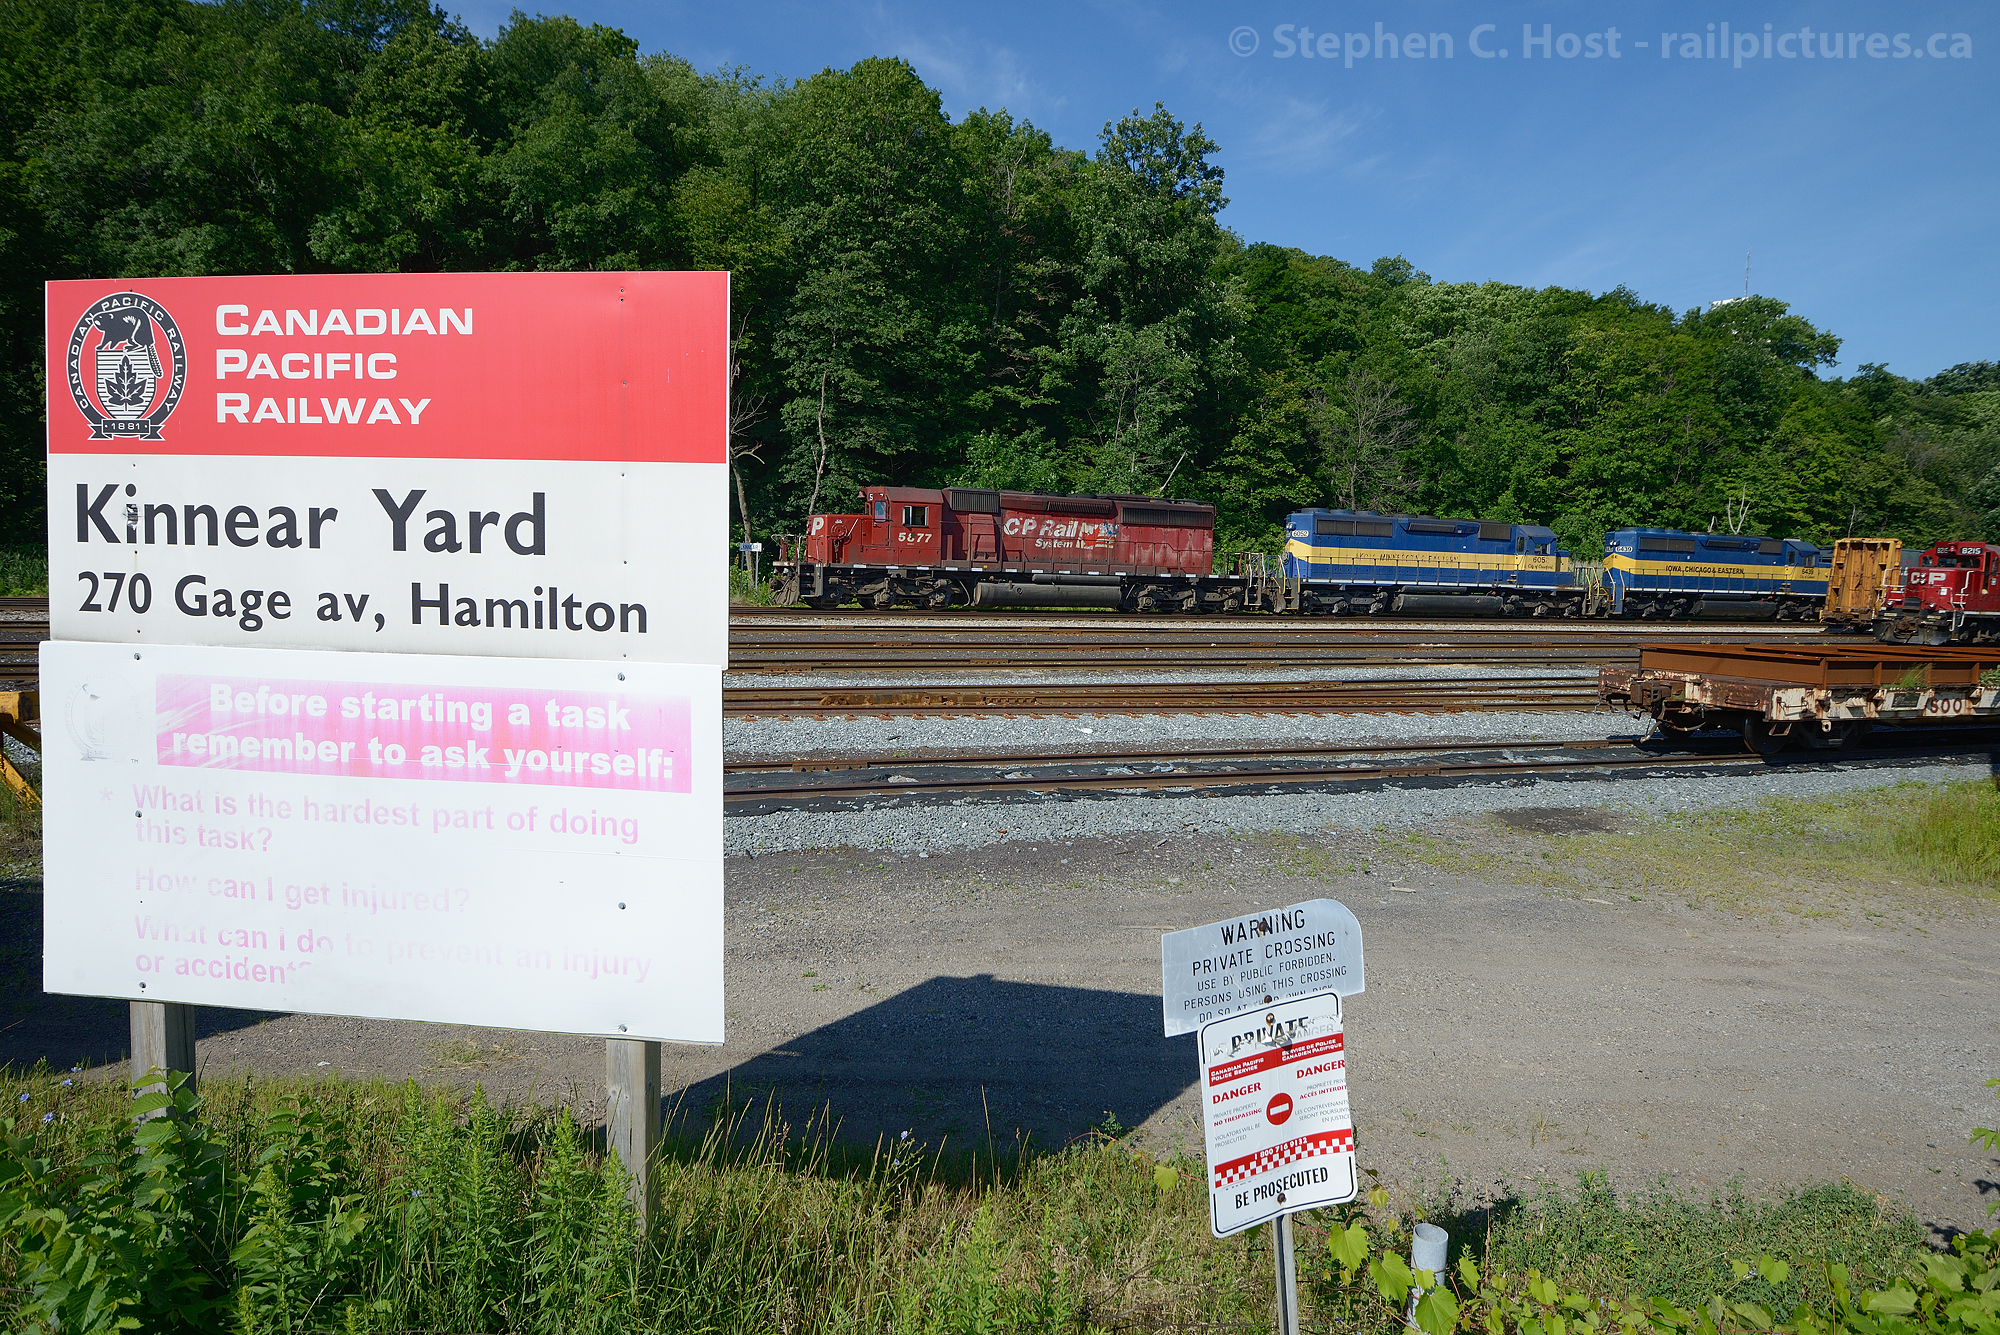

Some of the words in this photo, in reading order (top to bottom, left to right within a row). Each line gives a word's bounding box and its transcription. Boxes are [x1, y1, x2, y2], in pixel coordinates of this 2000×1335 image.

[216, 304, 473, 336] CANADIAN
[70, 312, 94, 409] CANADIAN
[101, 297, 164, 320] PACIFIC
[165, 328, 183, 412] RAILWAY
[216, 348, 398, 380] PACIFIC
[216, 393, 432, 425] RAILWAY
[76, 483, 338, 549] Kinnear
[372, 489, 546, 556] Yard
[1004, 516, 1037, 535] CP
[1039, 520, 1078, 537] Rail
[898, 532, 932, 543] 5877
[1035, 538, 1073, 549] System
[1911, 572, 1946, 584] CP
[78, 572, 152, 615] 270
[175, 575, 292, 634] Gage
[317, 592, 385, 633] av,
[412, 582, 648, 634] Hamilton
[209, 683, 327, 718] Before
[340, 691, 493, 731] starting
[508, 701, 531, 727] a
[545, 697, 631, 732] task
[173, 728, 355, 765] remember
[368, 735, 406, 766] to
[421, 741, 490, 770] ask
[505, 745, 673, 779] yourself:
[133, 783, 203, 814] What
[215, 790, 237, 816] is
[248, 792, 292, 820] the
[304, 795, 420, 827] hardest
[433, 804, 495, 833] part
[507, 806, 538, 832] of
[549, 809, 639, 844] doing
[135, 817, 187, 846] this
[198, 823, 273, 853] task?
[135, 867, 197, 893] How
[208, 873, 256, 901] can
[266, 877, 273, 901] I
[285, 882, 330, 911] get
[342, 883, 470, 914] injured?
[1221, 909, 1305, 945] WARNING
[135, 953, 164, 976] or
[218, 924, 267, 949] can
[297, 928, 333, 956] do
[346, 931, 374, 957] to
[387, 938, 503, 970] prevent
[515, 945, 552, 970] an
[563, 942, 652, 983] injury
[1193, 948, 1254, 976] PRIVATE
[1265, 931, 1335, 959] CROSSING
[1197, 979, 1216, 991] USE
[1223, 974, 1235, 987] BY
[1240, 965, 1273, 982] PUBLIC
[1279, 952, 1336, 973] FORBIDDEN.
[1184, 991, 1232, 1010] PERSONS
[1238, 983, 1267, 999] USING
[1273, 976, 1294, 989] THIS
[1300, 965, 1347, 984] CROSSING
[1282, 1050, 1311, 1061] CANADIEN
[1312, 1043, 1342, 1055] PACIFIQUE
[1315, 1039, 1336, 1048] POLICE
[1211, 1064, 1241, 1077] CANADIAN
[1243, 1057, 1264, 1068] PACIFIC
[1211, 1072, 1233, 1082] POLICE
[1234, 1065, 1258, 1077] SERVICE
[1296, 1060, 1345, 1079] DANGER
[1212, 1082, 1262, 1105] DANGER
[1213, 1107, 1232, 1119] PRIVATE
[1233, 1102, 1257, 1114] PROPERTY
[1224, 1108, 1262, 1124] TRESPASSING
[1294, 1108, 1303, 1116] LES
[1299, 1112, 1318, 1122] SERONT
[1214, 1128, 1242, 1141] VIOLATORS
[1242, 1124, 1254, 1133] WILL
[1215, 1134, 1247, 1148] PROSECUTED
[1260, 1148, 1273, 1158] 800
[1275, 1143, 1288, 1153] 716
[1289, 1137, 1308, 1148] 9132
[1235, 1191, 1250, 1209] BE
[1253, 1167, 1328, 1203] PROSECUTED
